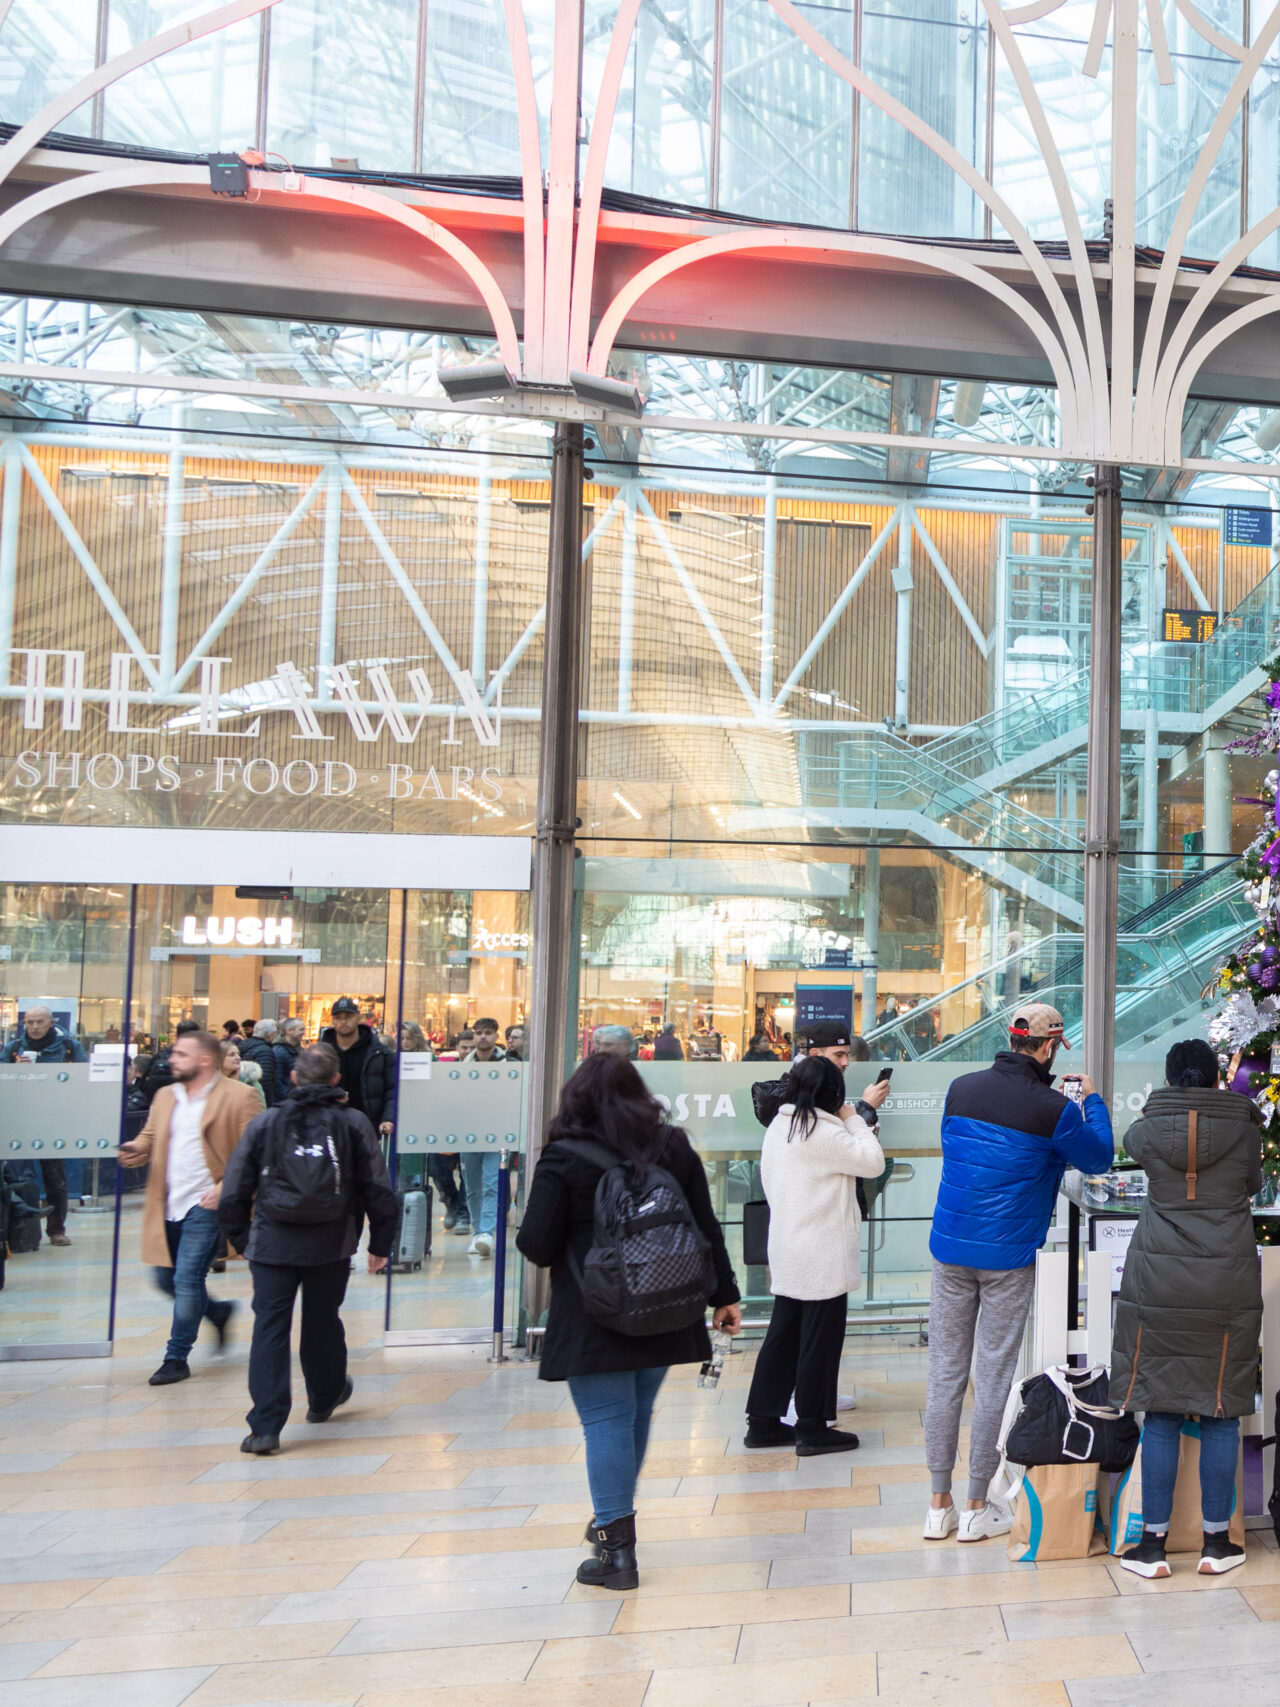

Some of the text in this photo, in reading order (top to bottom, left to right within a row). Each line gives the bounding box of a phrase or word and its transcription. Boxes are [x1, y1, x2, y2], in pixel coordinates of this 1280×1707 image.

[188, 657, 510, 747] LAWN
[15, 750, 504, 803] SHOPS FOOD BARS
[182, 916, 293, 945] LUSH
[652, 1093, 737, 1122] OSTA
[897, 1100, 937, 1109] BISHOP
